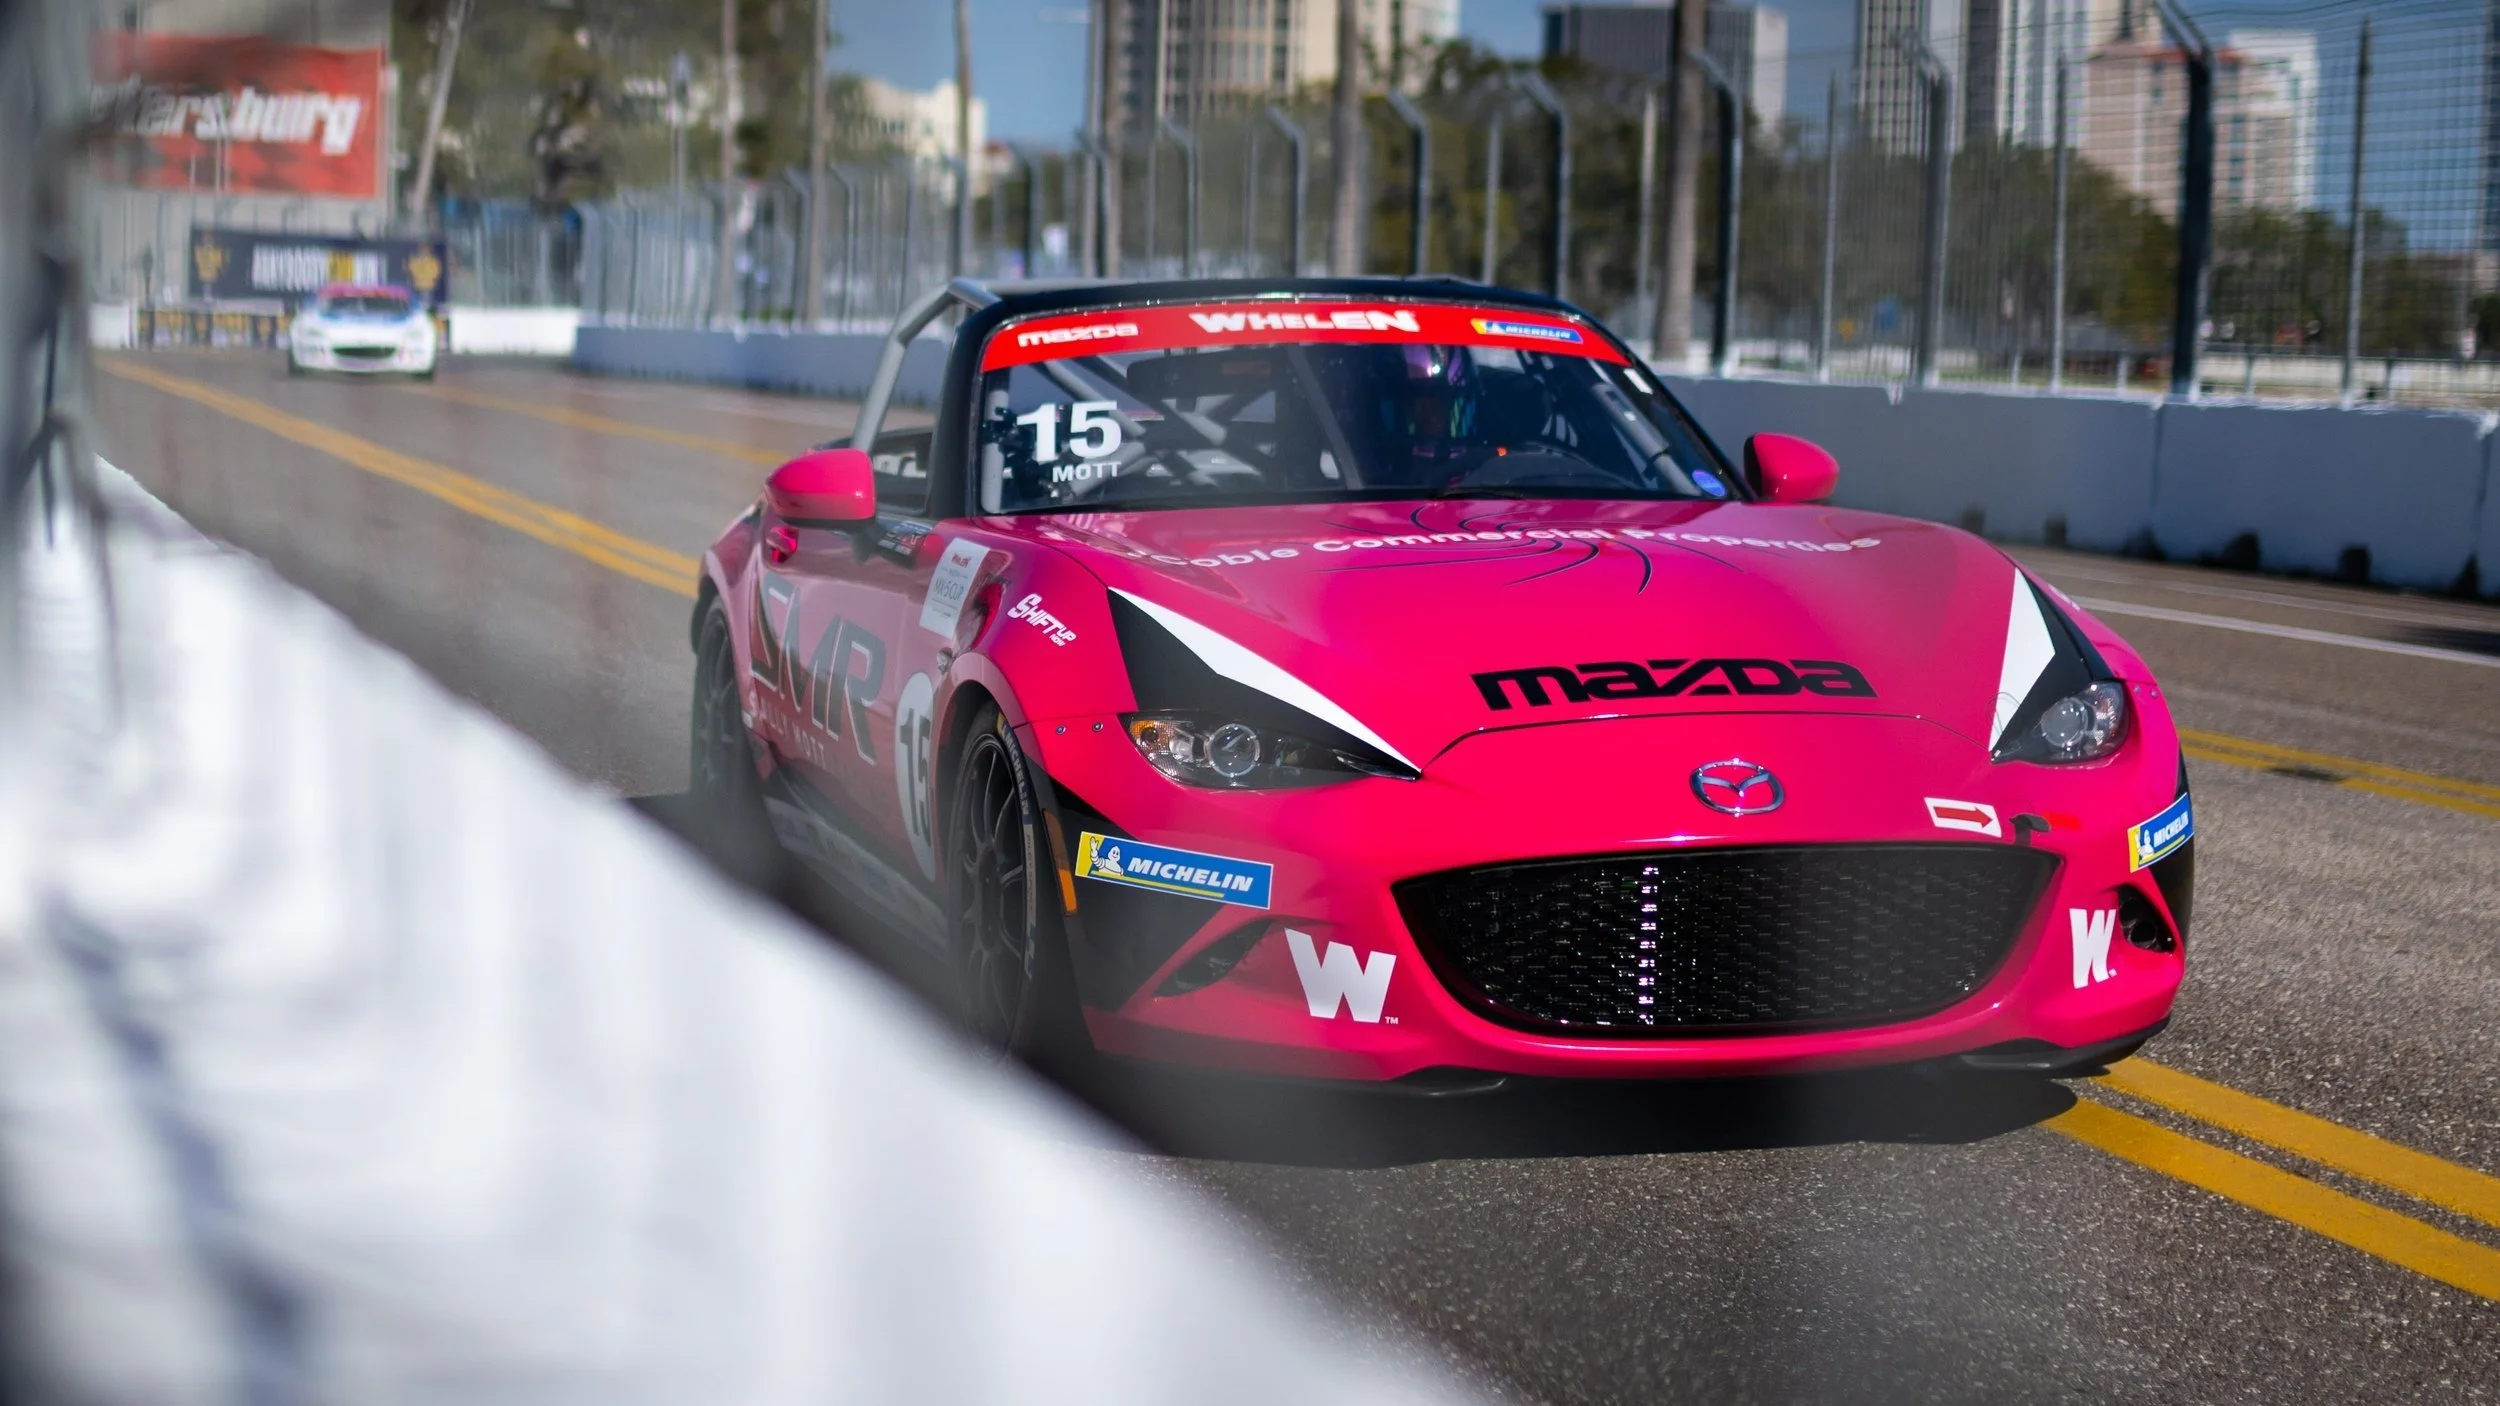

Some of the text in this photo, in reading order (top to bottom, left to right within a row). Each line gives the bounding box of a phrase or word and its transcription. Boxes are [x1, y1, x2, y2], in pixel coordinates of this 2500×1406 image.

[1505, 325, 1571, 340] MICHELIN
[1016, 400, 1122, 464] 15
[1052, 461, 1122, 483] MOTT
[1149, 527, 1882, 568] Coble Commercial Properties
[899, 707, 932, 847] 15
[1003, 731, 1029, 816] MICHELIN
[2153, 809, 2190, 848] MICHELIN
[1127, 856, 1253, 893] MICHELIN
